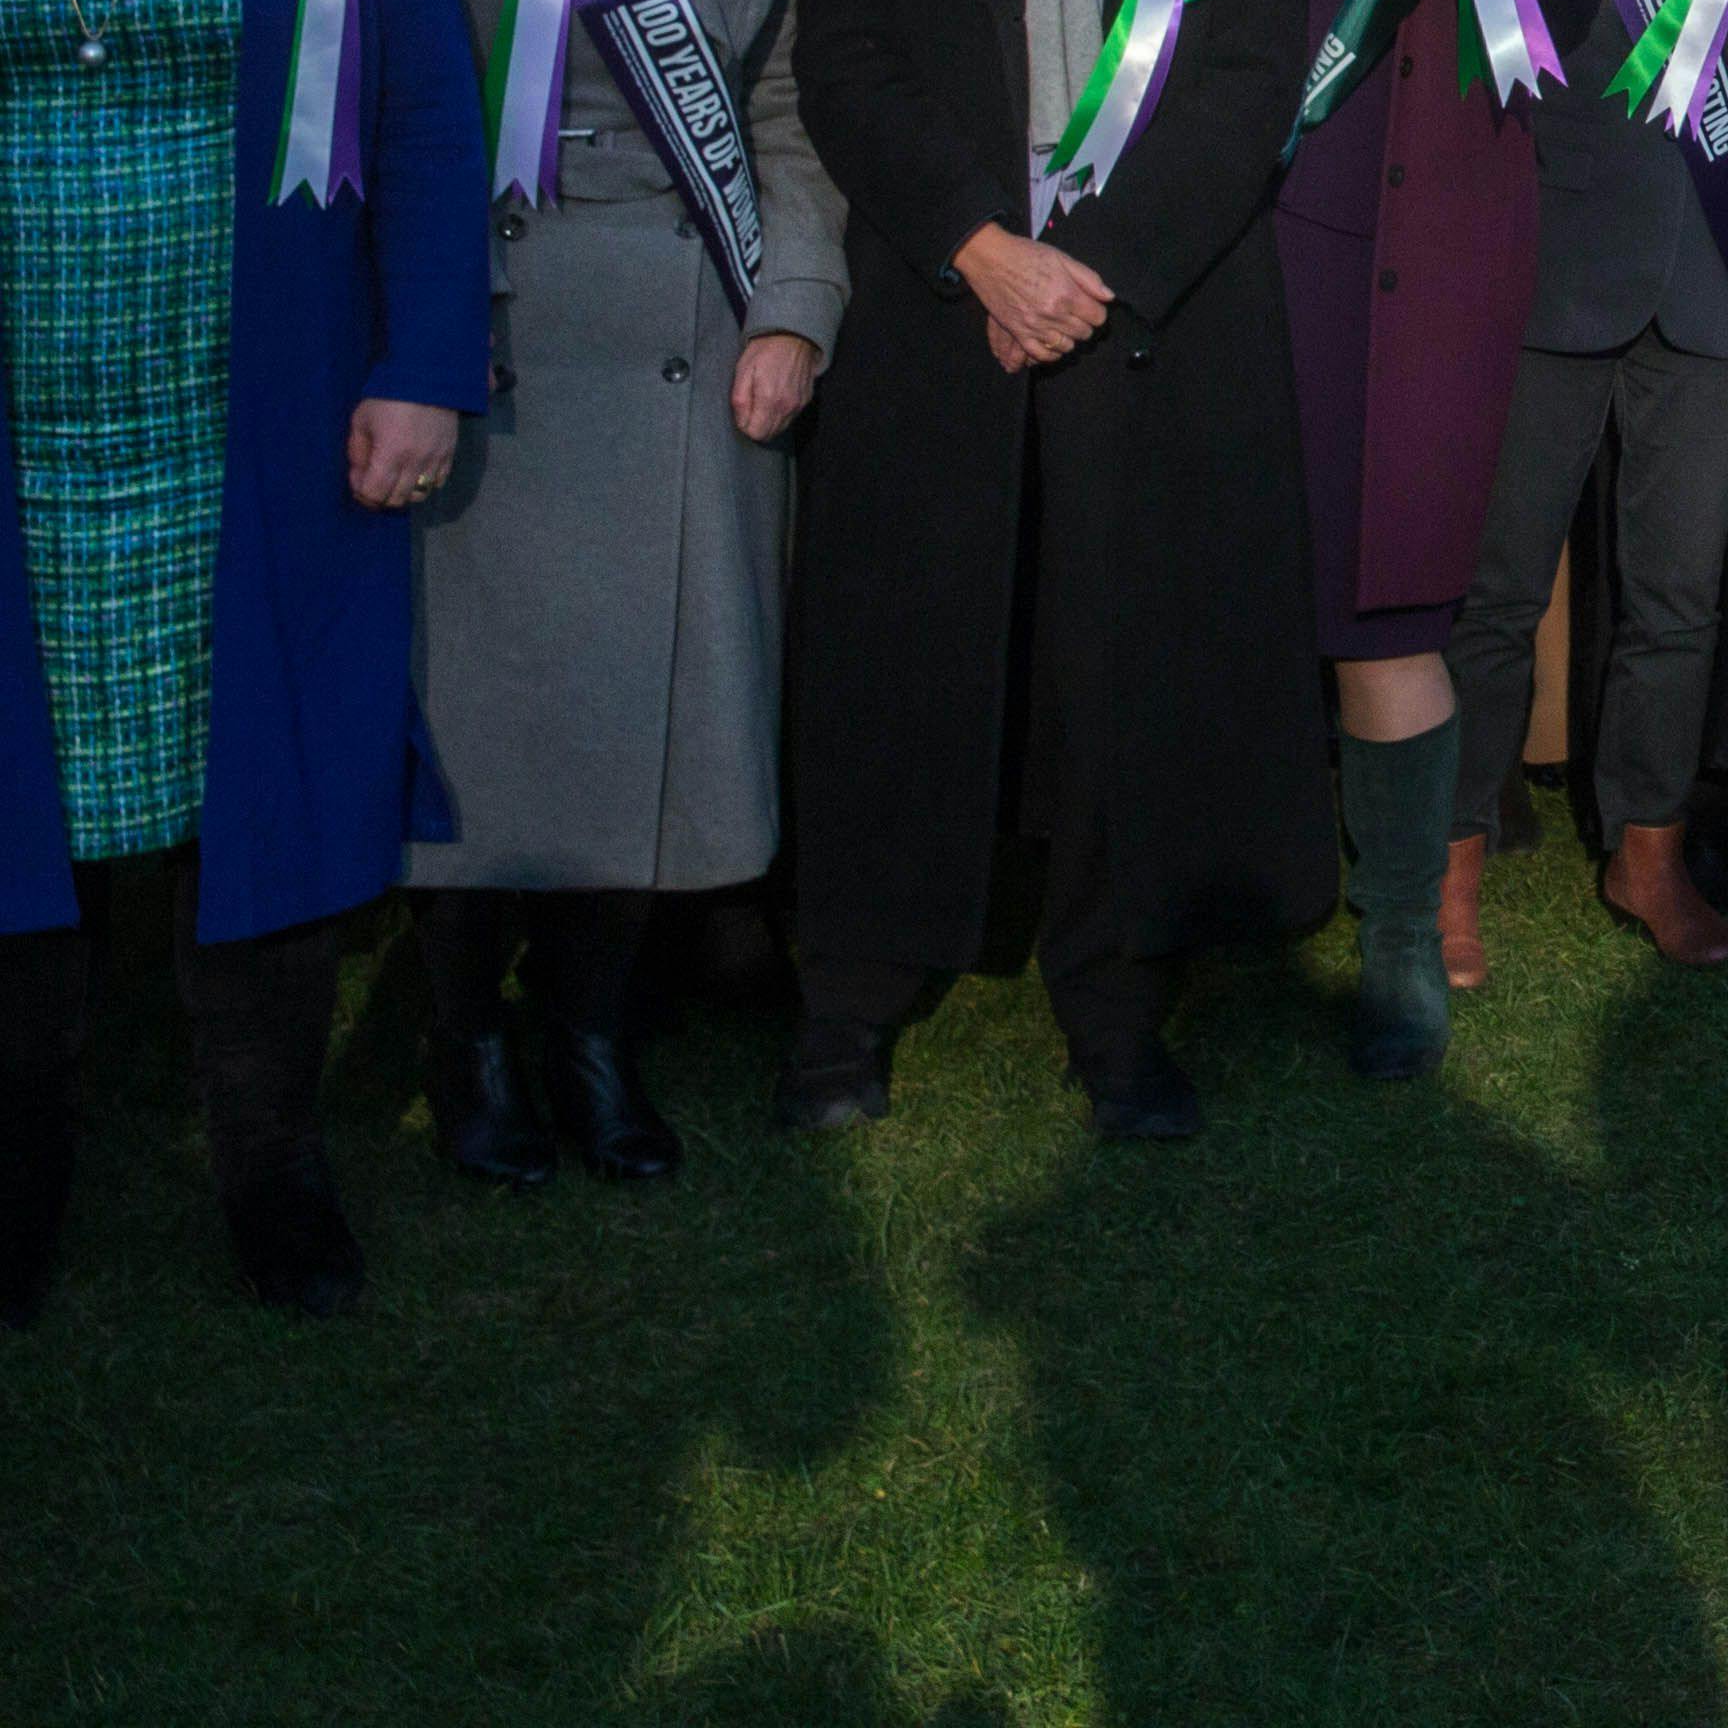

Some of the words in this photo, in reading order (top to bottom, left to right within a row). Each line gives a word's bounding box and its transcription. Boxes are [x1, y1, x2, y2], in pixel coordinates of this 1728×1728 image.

[659, 43, 729, 139] YEARS
[703, 135, 739, 172] OF
[723, 167, 762, 269] WOMEN
